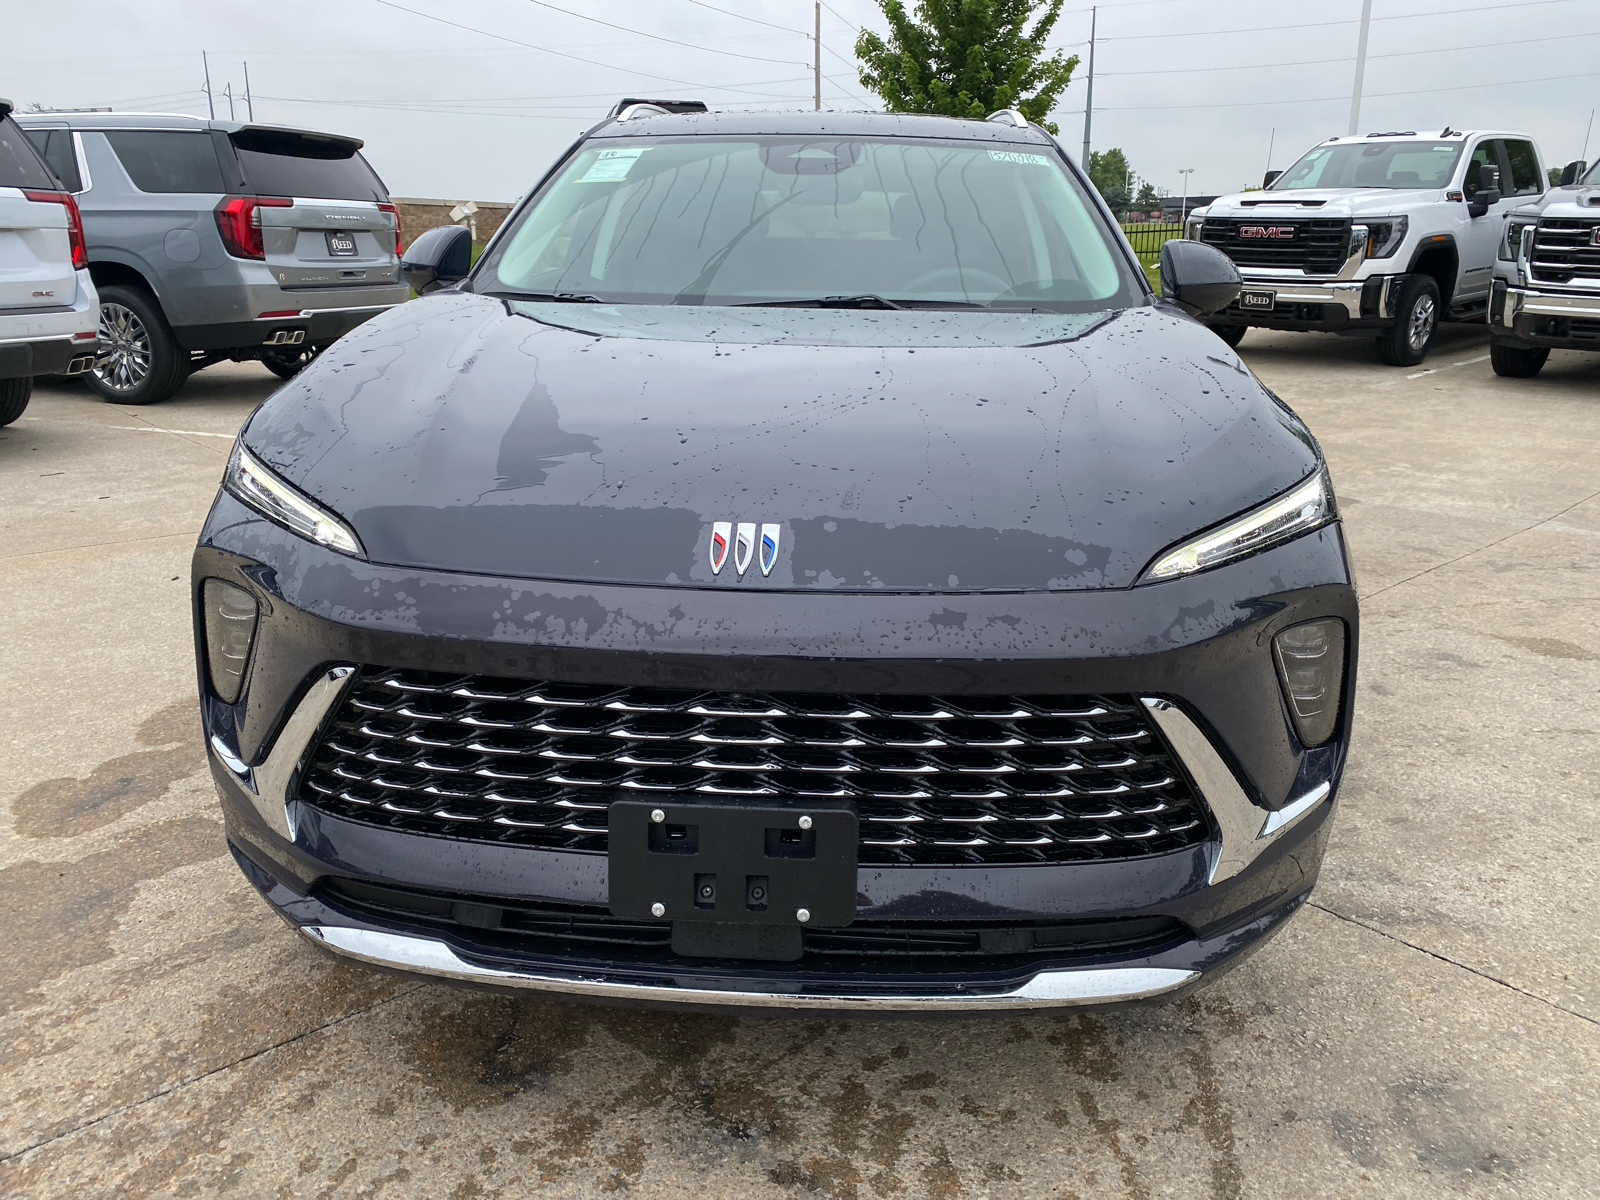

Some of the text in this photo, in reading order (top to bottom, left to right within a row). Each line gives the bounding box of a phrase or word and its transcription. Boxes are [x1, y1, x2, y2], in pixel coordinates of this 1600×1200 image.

[1240, 226, 1294, 239] GMC
[331, 238, 352, 251] REED
[1244, 294, 1270, 305] REED
